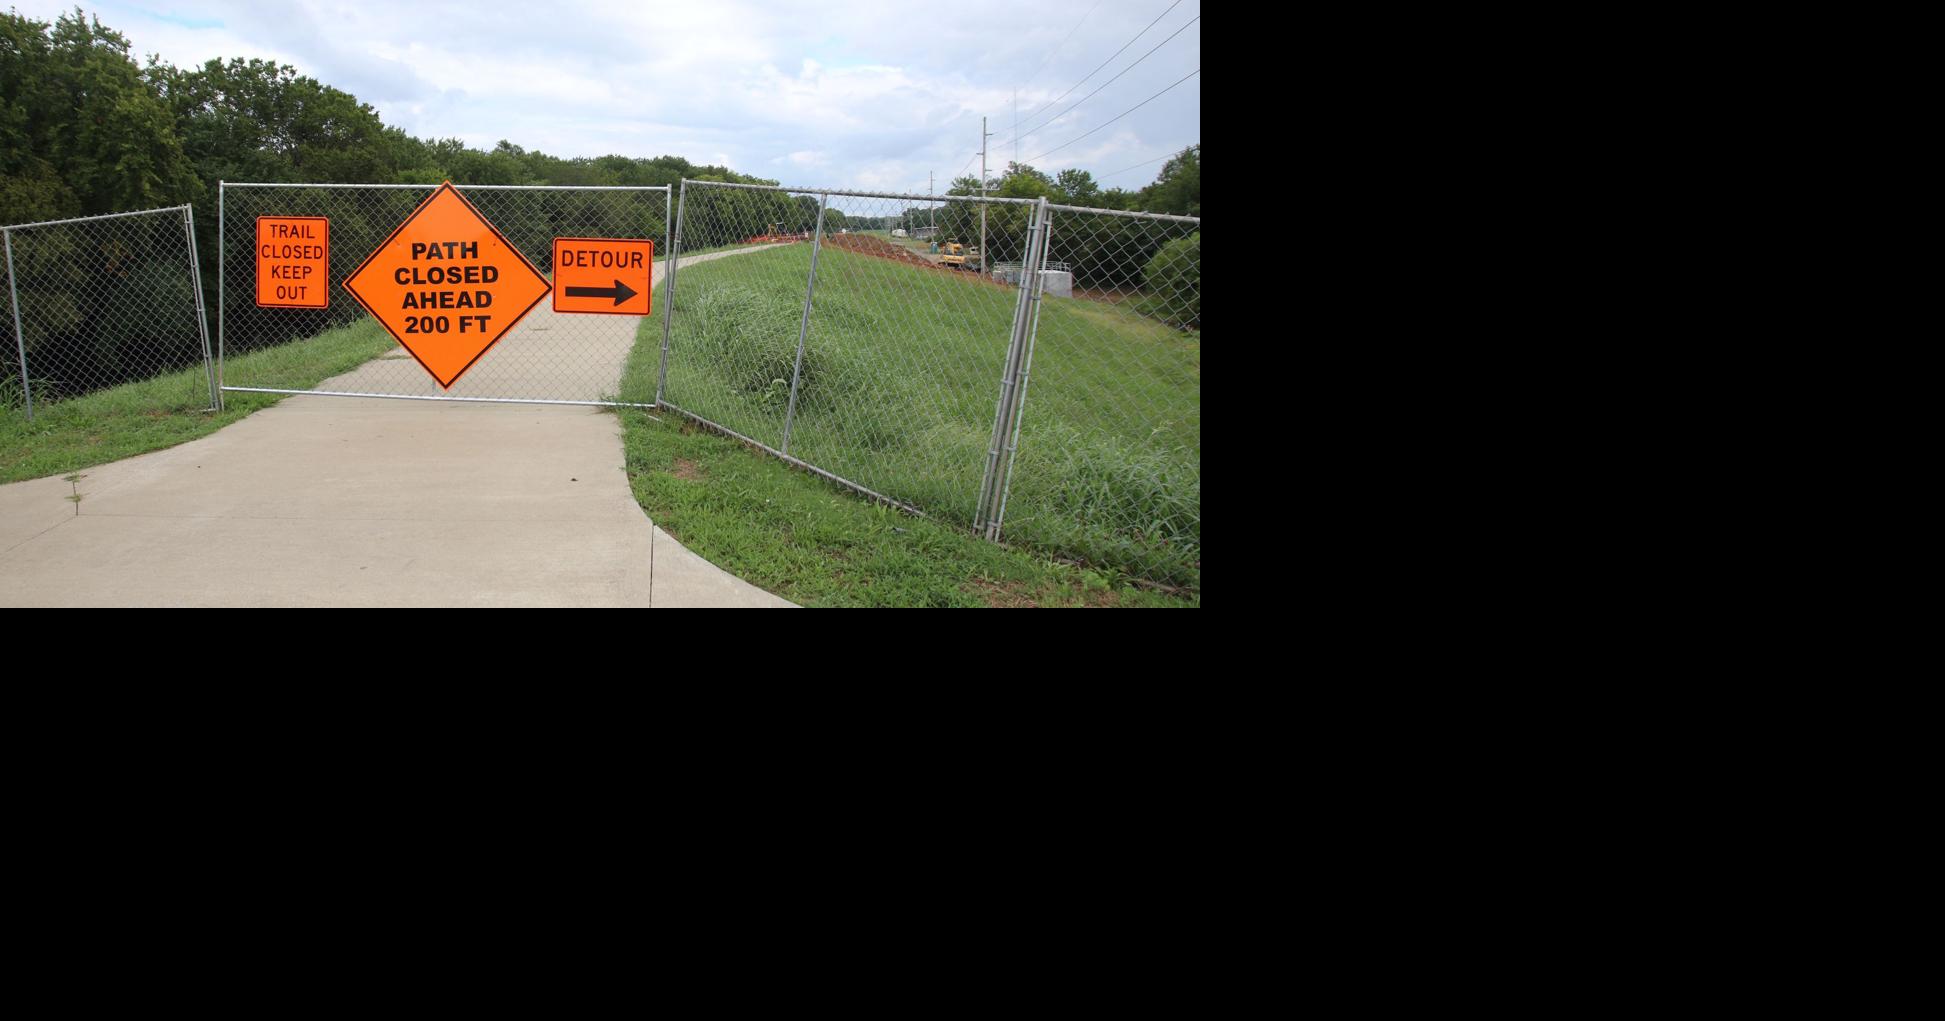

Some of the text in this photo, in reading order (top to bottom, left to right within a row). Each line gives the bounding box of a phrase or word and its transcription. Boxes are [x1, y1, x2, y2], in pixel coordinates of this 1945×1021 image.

[270, 224, 315, 239] TRAIL
[261, 244, 323, 260] CLOSED
[411, 241, 479, 261] PATH
[561, 249, 644, 269] DETOUR
[271, 265, 312, 280] KEEP
[394, 265, 499, 286] CLOSED
[276, 285, 307, 300] OUT
[401, 290, 493, 310] AHEAD
[404, 315, 491, 334] 200 FT
